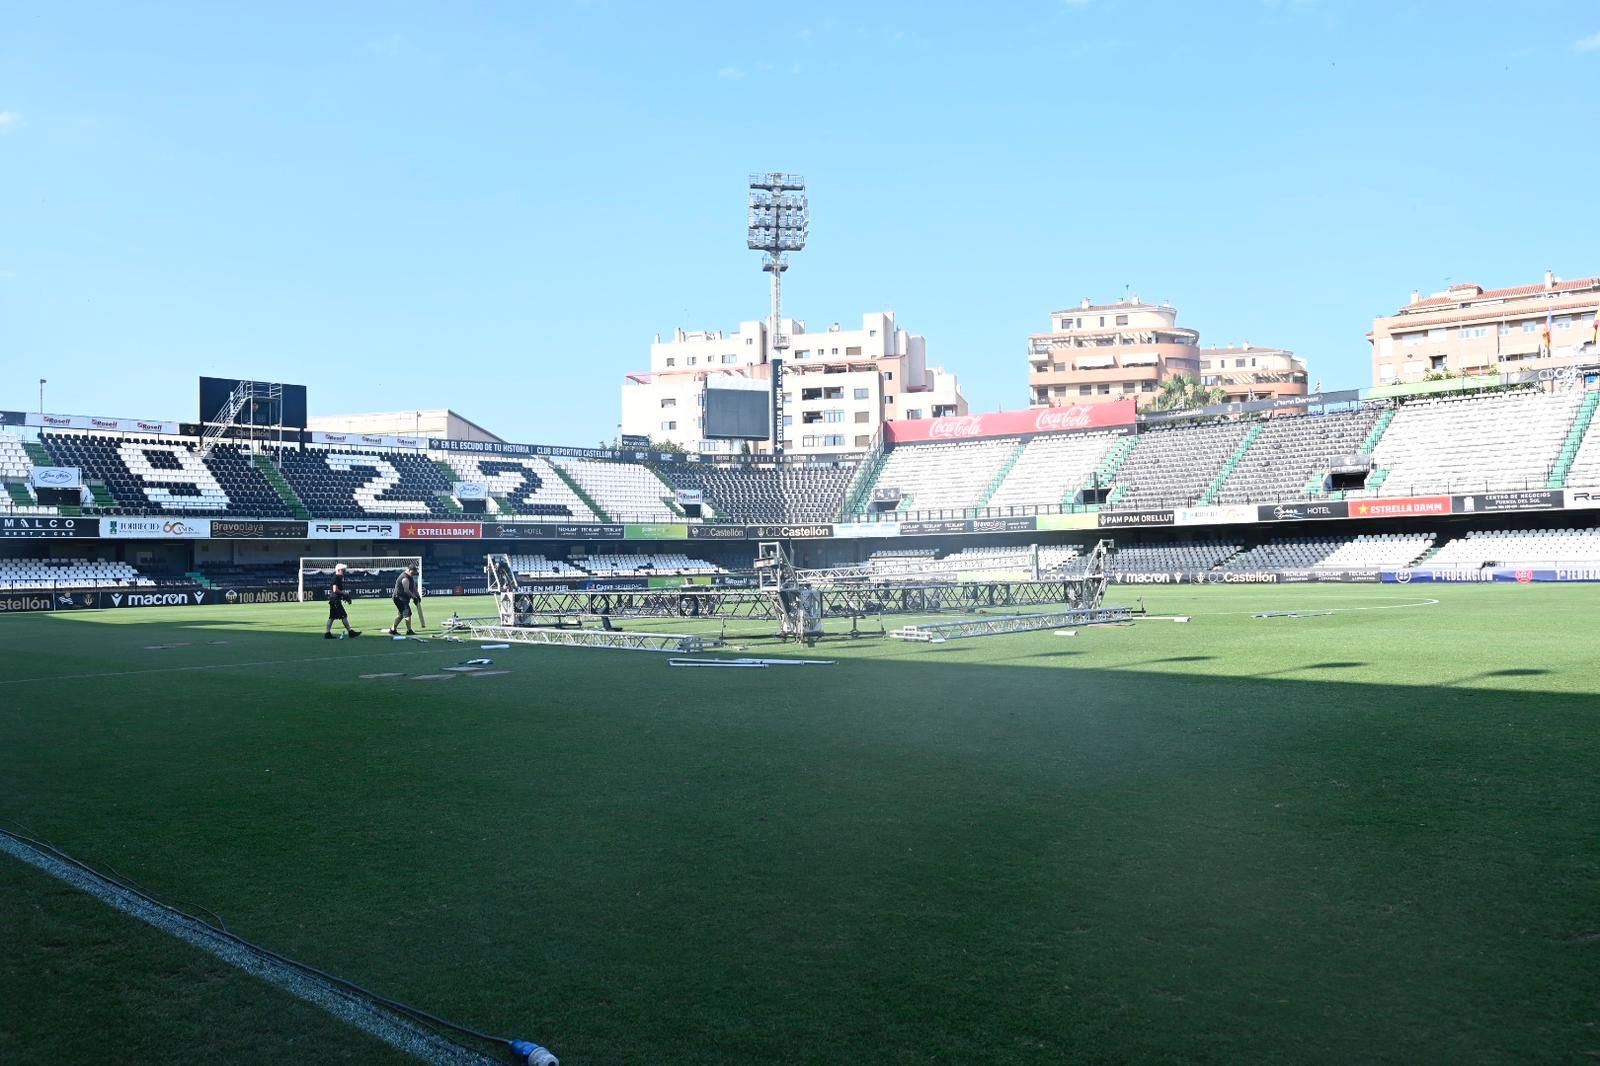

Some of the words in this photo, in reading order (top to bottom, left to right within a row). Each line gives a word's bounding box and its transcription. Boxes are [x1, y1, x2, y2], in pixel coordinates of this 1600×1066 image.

[441, 441, 450, 449] EN
[451, 441, 459, 449] EL
[460, 441, 484, 451] ESCUDO
[485, 443, 493, 451] DE
[494, 444, 502, 452] TU
[503, 444, 530, 454] HISTORIA
[537, 447, 551, 455] CLUB
[553, 448, 582, 457] DEPORTIVO
[1307, 506, 1332, 514] HOTEL
[1370, 504, 1412, 513] ESTRELLA
[1413, 503, 1443, 512] DAMM
[1106, 515, 1123, 523] PAM
[1124, 514, 1140, 523] PAM
[1141, 513, 1174, 522] ORELLUT
[4, 519, 75, 528] MALCO
[212, 522, 264, 532] Bravoplaya
[316, 525, 393, 533] REPCAR
[417, 528, 452, 536] ESTRELLA
[453, 528, 475, 536] DAMM
[523, 528, 543, 536] HOTEL
[1126, 572, 1170, 583] macron
[128, 594, 188, 606] macron
[239, 592, 255, 603] 100
[256, 590, 279, 603] AÑOS
[280, 592, 286, 602] A
[287, 591, 314, 601] COOR
